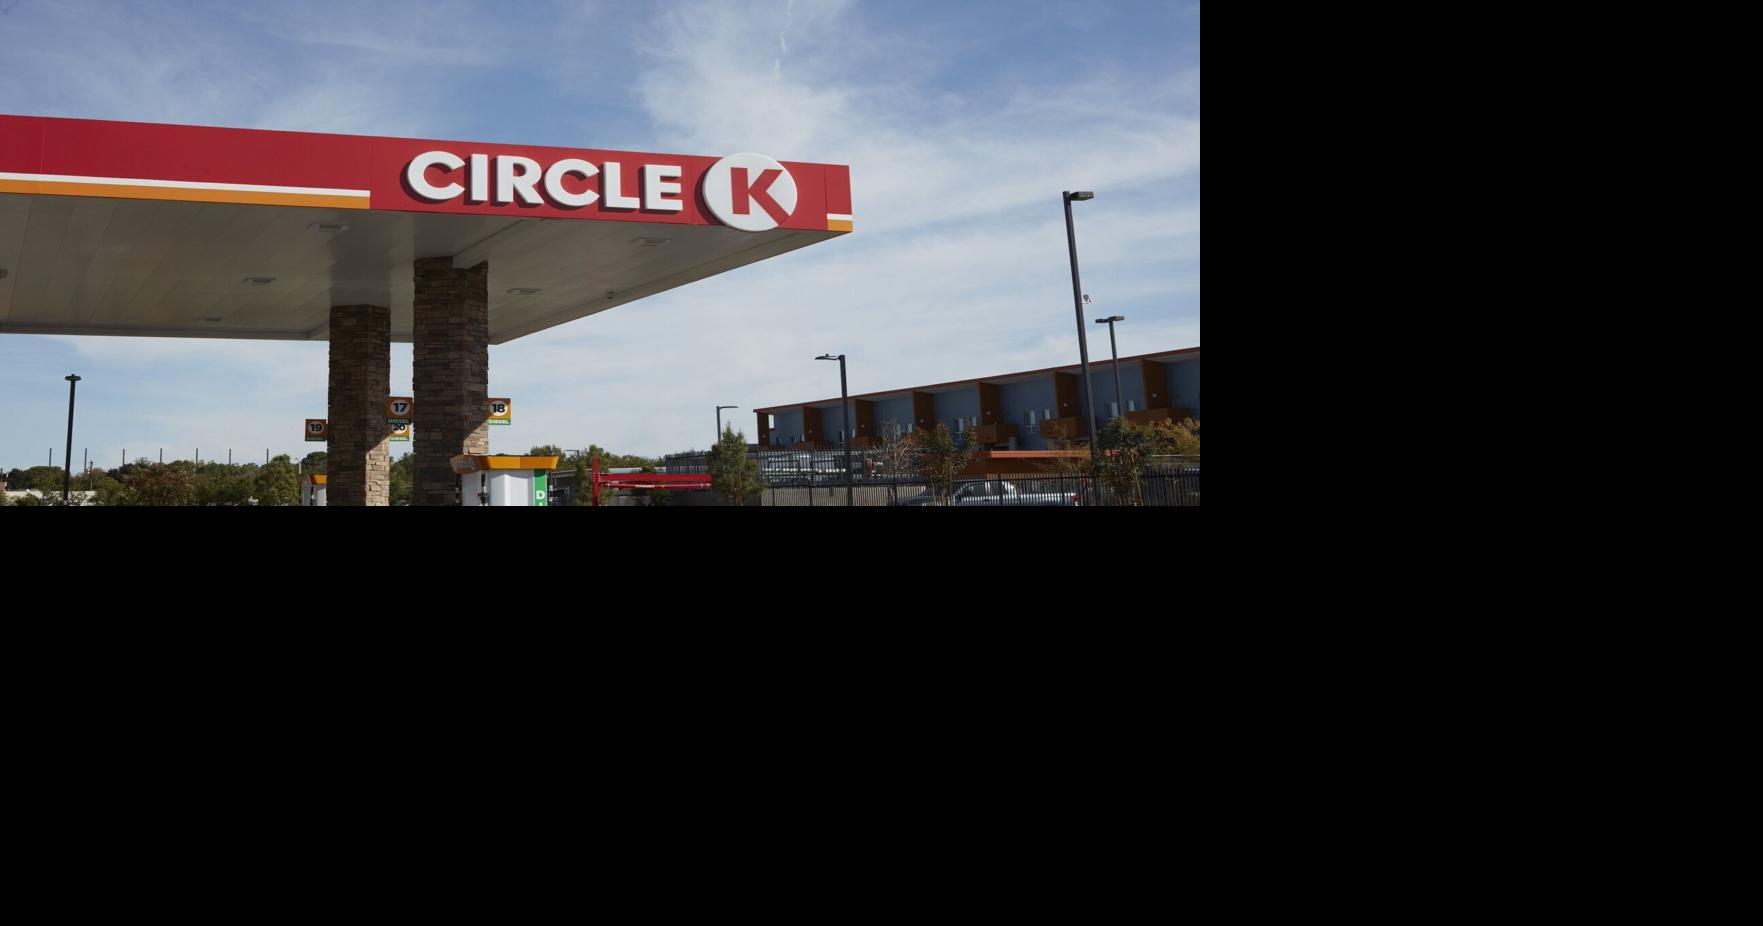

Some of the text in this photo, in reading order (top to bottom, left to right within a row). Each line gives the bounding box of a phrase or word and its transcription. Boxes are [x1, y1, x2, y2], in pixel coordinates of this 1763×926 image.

[405, 150, 791, 227] CIRCLE K
[393, 403, 408, 412] 17
[491, 404, 506, 413] 18
[310, 423, 322, 431] 19
